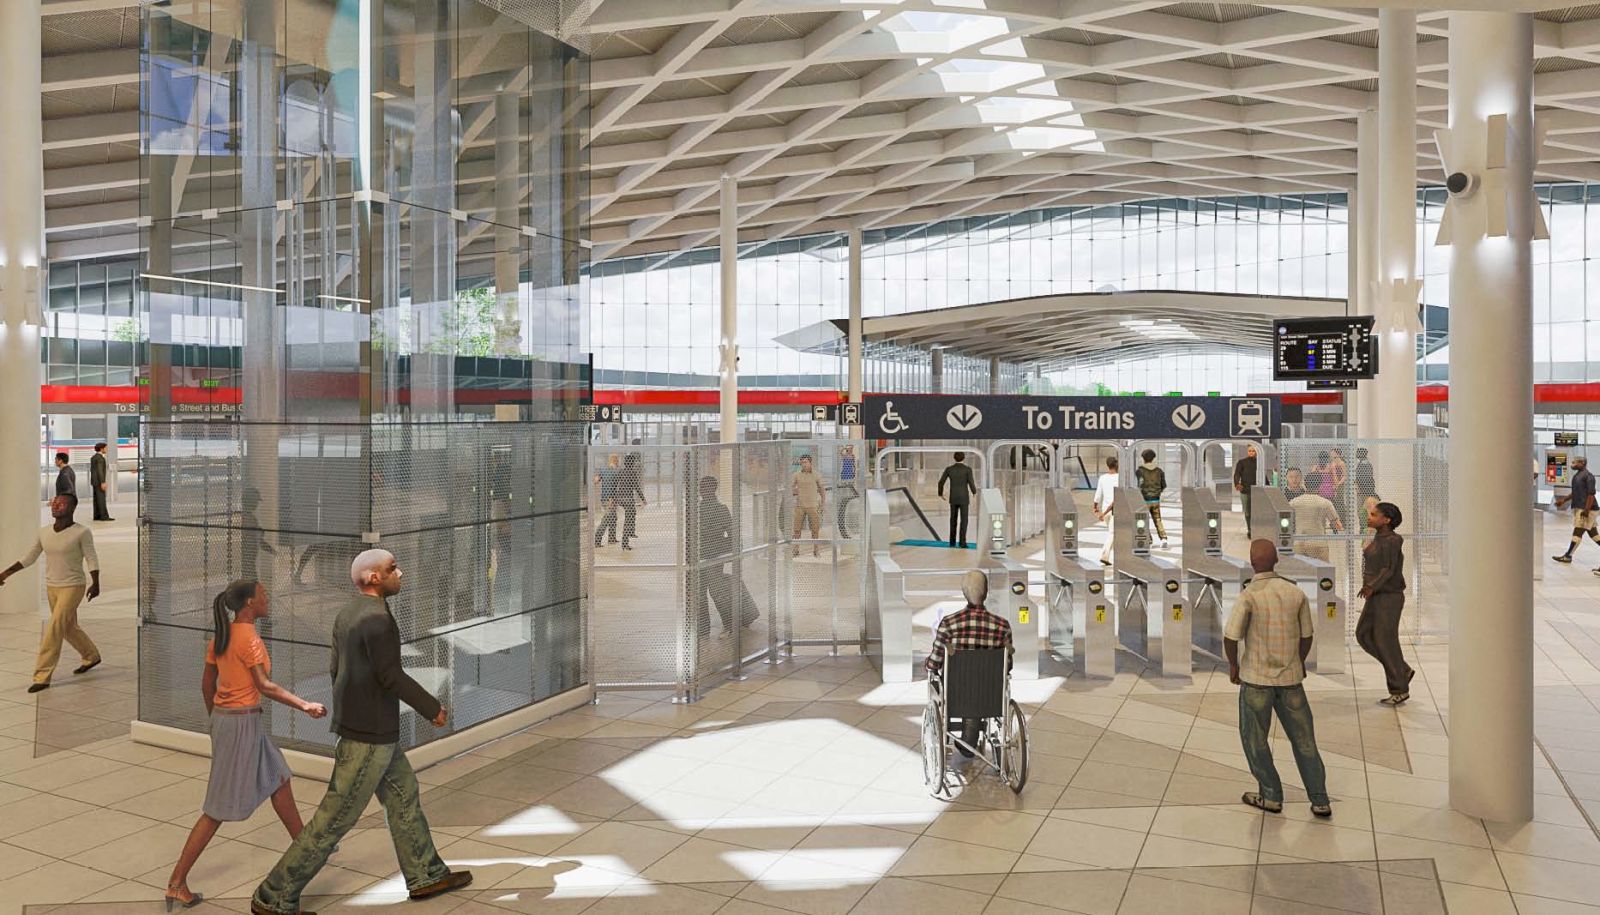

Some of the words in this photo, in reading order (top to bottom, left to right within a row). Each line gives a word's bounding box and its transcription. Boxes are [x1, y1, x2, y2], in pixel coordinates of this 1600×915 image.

[114, 403, 126, 412] To
[179, 403, 203, 412] Street
[204, 403, 220, 412] and
[221, 403, 236, 412] Bus
[1022, 405, 1053, 430] To
[1059, 405, 1135, 430] Trains
